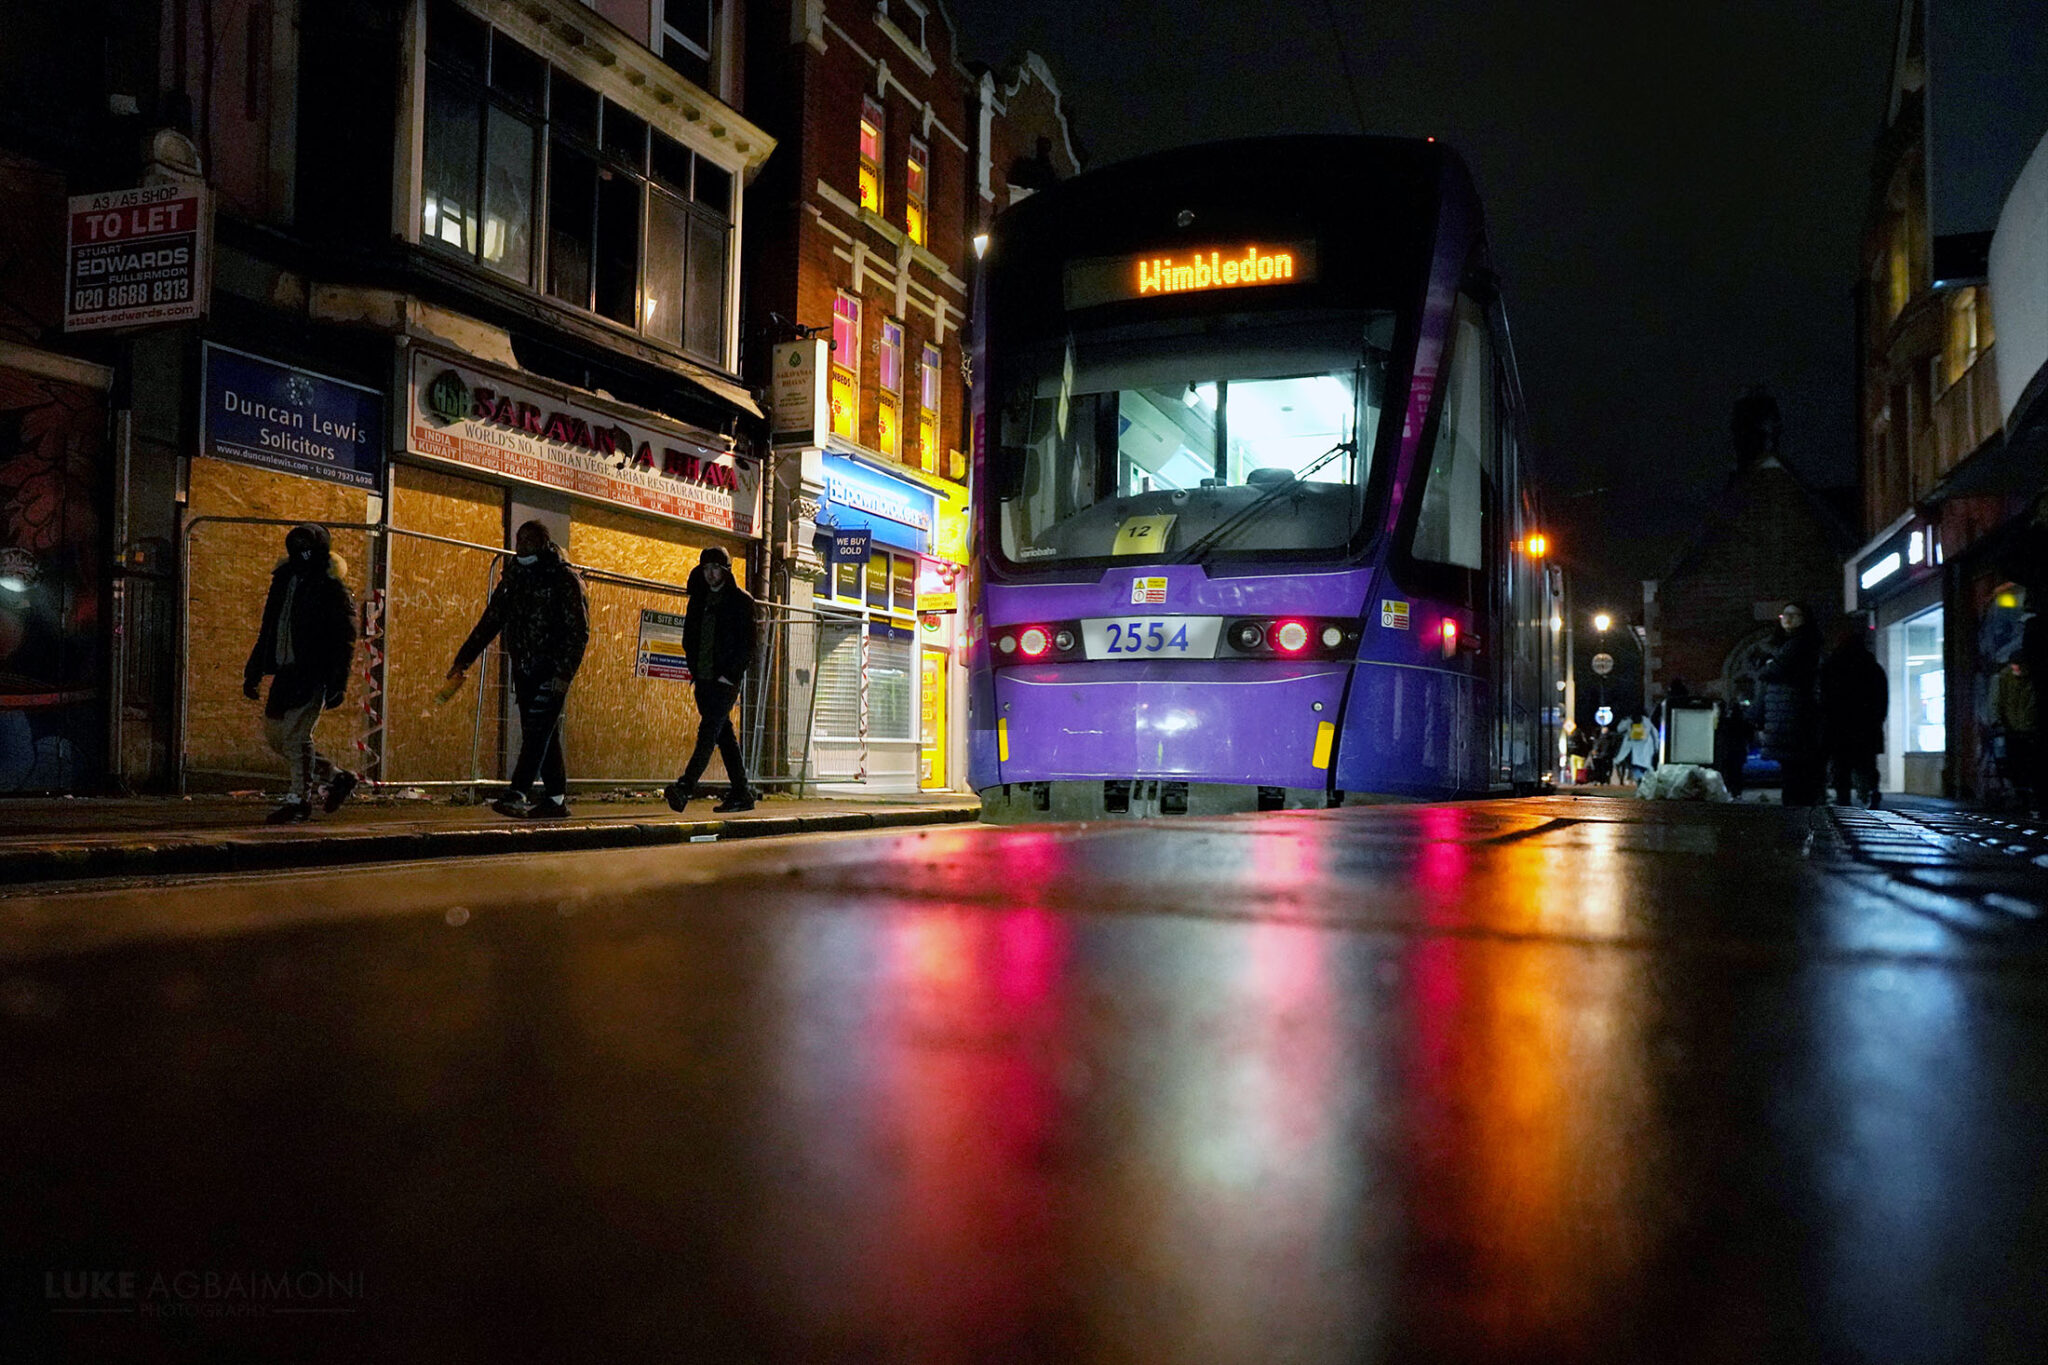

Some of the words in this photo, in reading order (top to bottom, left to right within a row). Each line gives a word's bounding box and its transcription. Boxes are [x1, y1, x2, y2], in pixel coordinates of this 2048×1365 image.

[93, 197, 109, 210] A3
[120, 192, 137, 206] A5
[142, 187, 178, 203] SHOP
[86, 213, 122, 240] TO
[131, 204, 184, 234] LET
[78, 245, 121, 258] STUART
[76, 247, 189, 277] EDWARDS
[1139, 247, 1292, 293] Wimbledon
[108, 267, 188, 284] FULLERMOON
[75, 287, 104, 311] 020
[108, 283, 148, 307] 8688
[152, 278, 188, 303] 8313
[68, 306, 193, 326] stuart-edwards.com
[225, 390, 302, 428] Duncan
[312, 413, 366, 444] Lewis
[260, 428, 335, 461] Solicitors
[424, 429, 451, 446] INDIA
[418, 441, 457, 459] KUWAIT
[463, 440, 500, 458] SINGAPORE
[217, 445, 309, 472] www.duncanlewis.com
[322, 468, 336, 478] 020
[465, 424, 515, 451] WORLD'S
[518, 438, 535, 456] NO.
[540, 446, 543, 458] 1
[547, 447, 582, 469] INDIAN
[583, 456, 644, 487] VEGEARIAN
[648, 474, 704, 503] RESTAURANT
[704, 488, 731, 508] CHAIN
[504, 451, 538, 468] MALAYSIA
[505, 463, 538, 480] FRANCE
[543, 461, 574, 479] THAILAND
[543, 473, 575, 490] GERMANY
[612, 491, 640, 506] CANADA
[677, 498, 696, 510] OMAN
[704, 506, 723, 517] QATAR
[1128, 525, 1151, 538] 12
[837, 538, 849, 546] WE
[850, 538, 866, 546] BUY
[840, 547, 862, 555] GOLD
[657, 615, 673, 625] SITE
[1106, 622, 1189, 655] 2554
